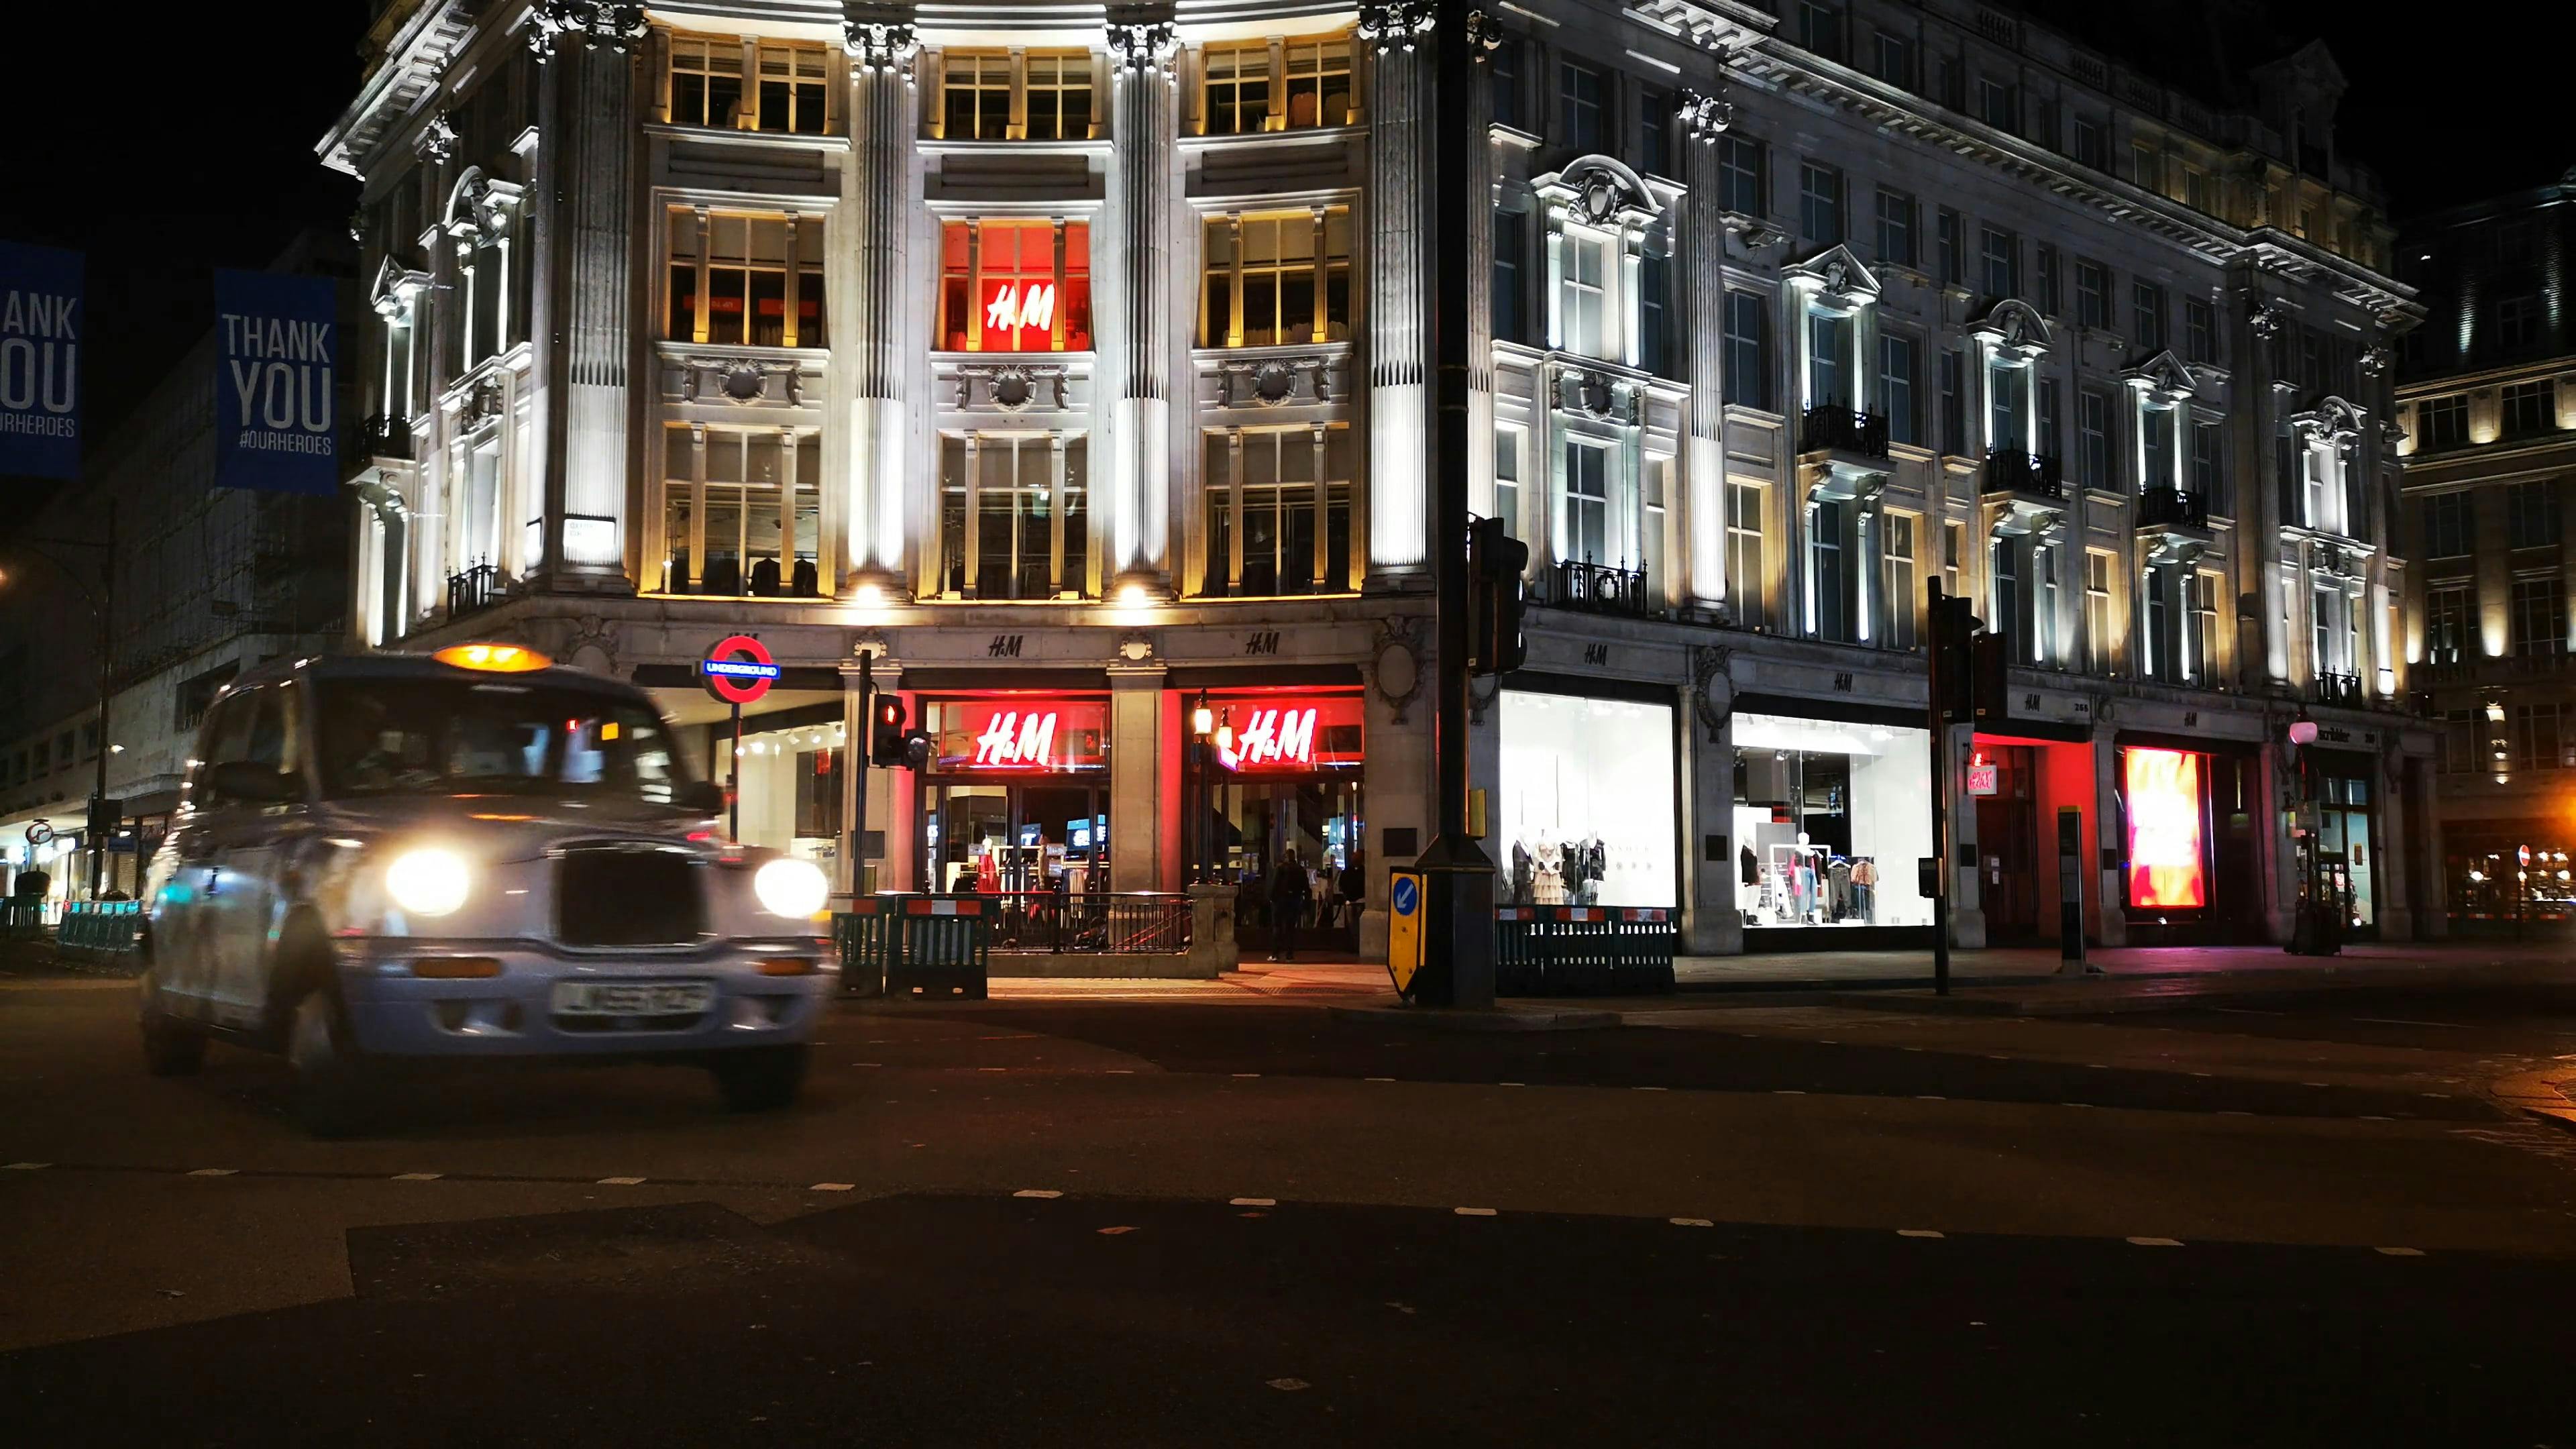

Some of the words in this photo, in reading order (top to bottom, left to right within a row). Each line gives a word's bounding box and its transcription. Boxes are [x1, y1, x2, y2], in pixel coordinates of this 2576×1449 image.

[3, 290, 77, 339] ANK
[987, 284, 1055, 331] H&M
[222, 313, 330, 364] THANK
[1, 337, 76, 413] OU
[230, 360, 331, 433] YOU
[0, 412, 75, 437] RHEROES
[239, 430, 331, 455] #OURHEROES
[988, 635, 1024, 657] H&M
[1246, 632, 1280, 655] H&M
[706, 663, 777, 676] UNDERGROUND
[976, 712, 1057, 765] H&M
[1238, 708, 1316, 763] H&M
